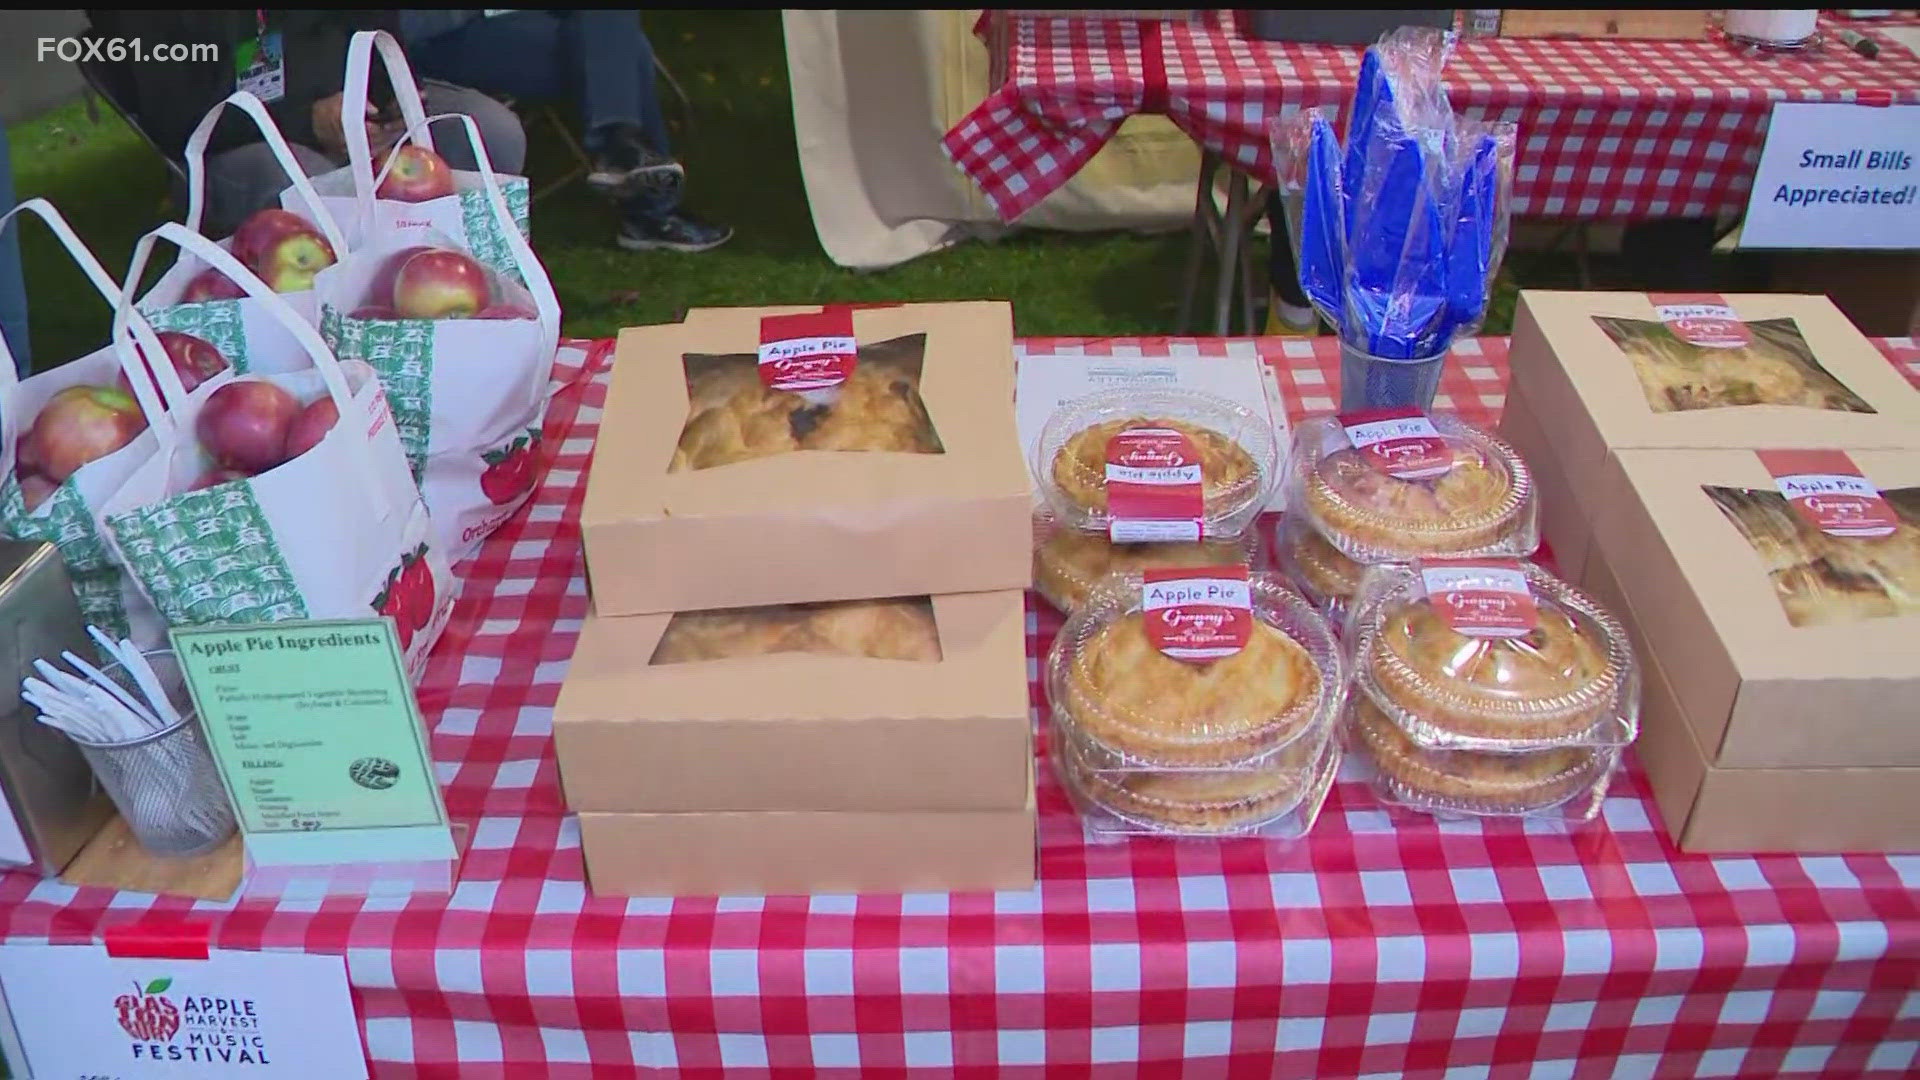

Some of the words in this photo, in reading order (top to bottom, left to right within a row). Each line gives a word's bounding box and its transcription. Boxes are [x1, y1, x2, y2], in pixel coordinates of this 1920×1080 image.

[1799, 149, 1862, 169] Small
[1866, 151, 1913, 170] Bills
[1774, 184, 1918, 207] Appreciated!
[769, 344, 816, 356] Apple
[822, 340, 848, 350] Pie
[1786, 480, 1834, 493] Apple
[1835, 480, 1864, 491] Pie
[1150, 587, 1202, 604] Apple
[1207, 584, 1236, 599] Pie
[190, 638, 243, 659] Apple
[246, 636, 275, 651] Pie
[278, 632, 382, 652] Ingredients
[184, 996, 257, 1016] APPLE
[185, 1014, 259, 1029] HARVEST
[189, 1032, 264, 1048] MUSIC
[132, 1042, 271, 1065] FESTIVAL
